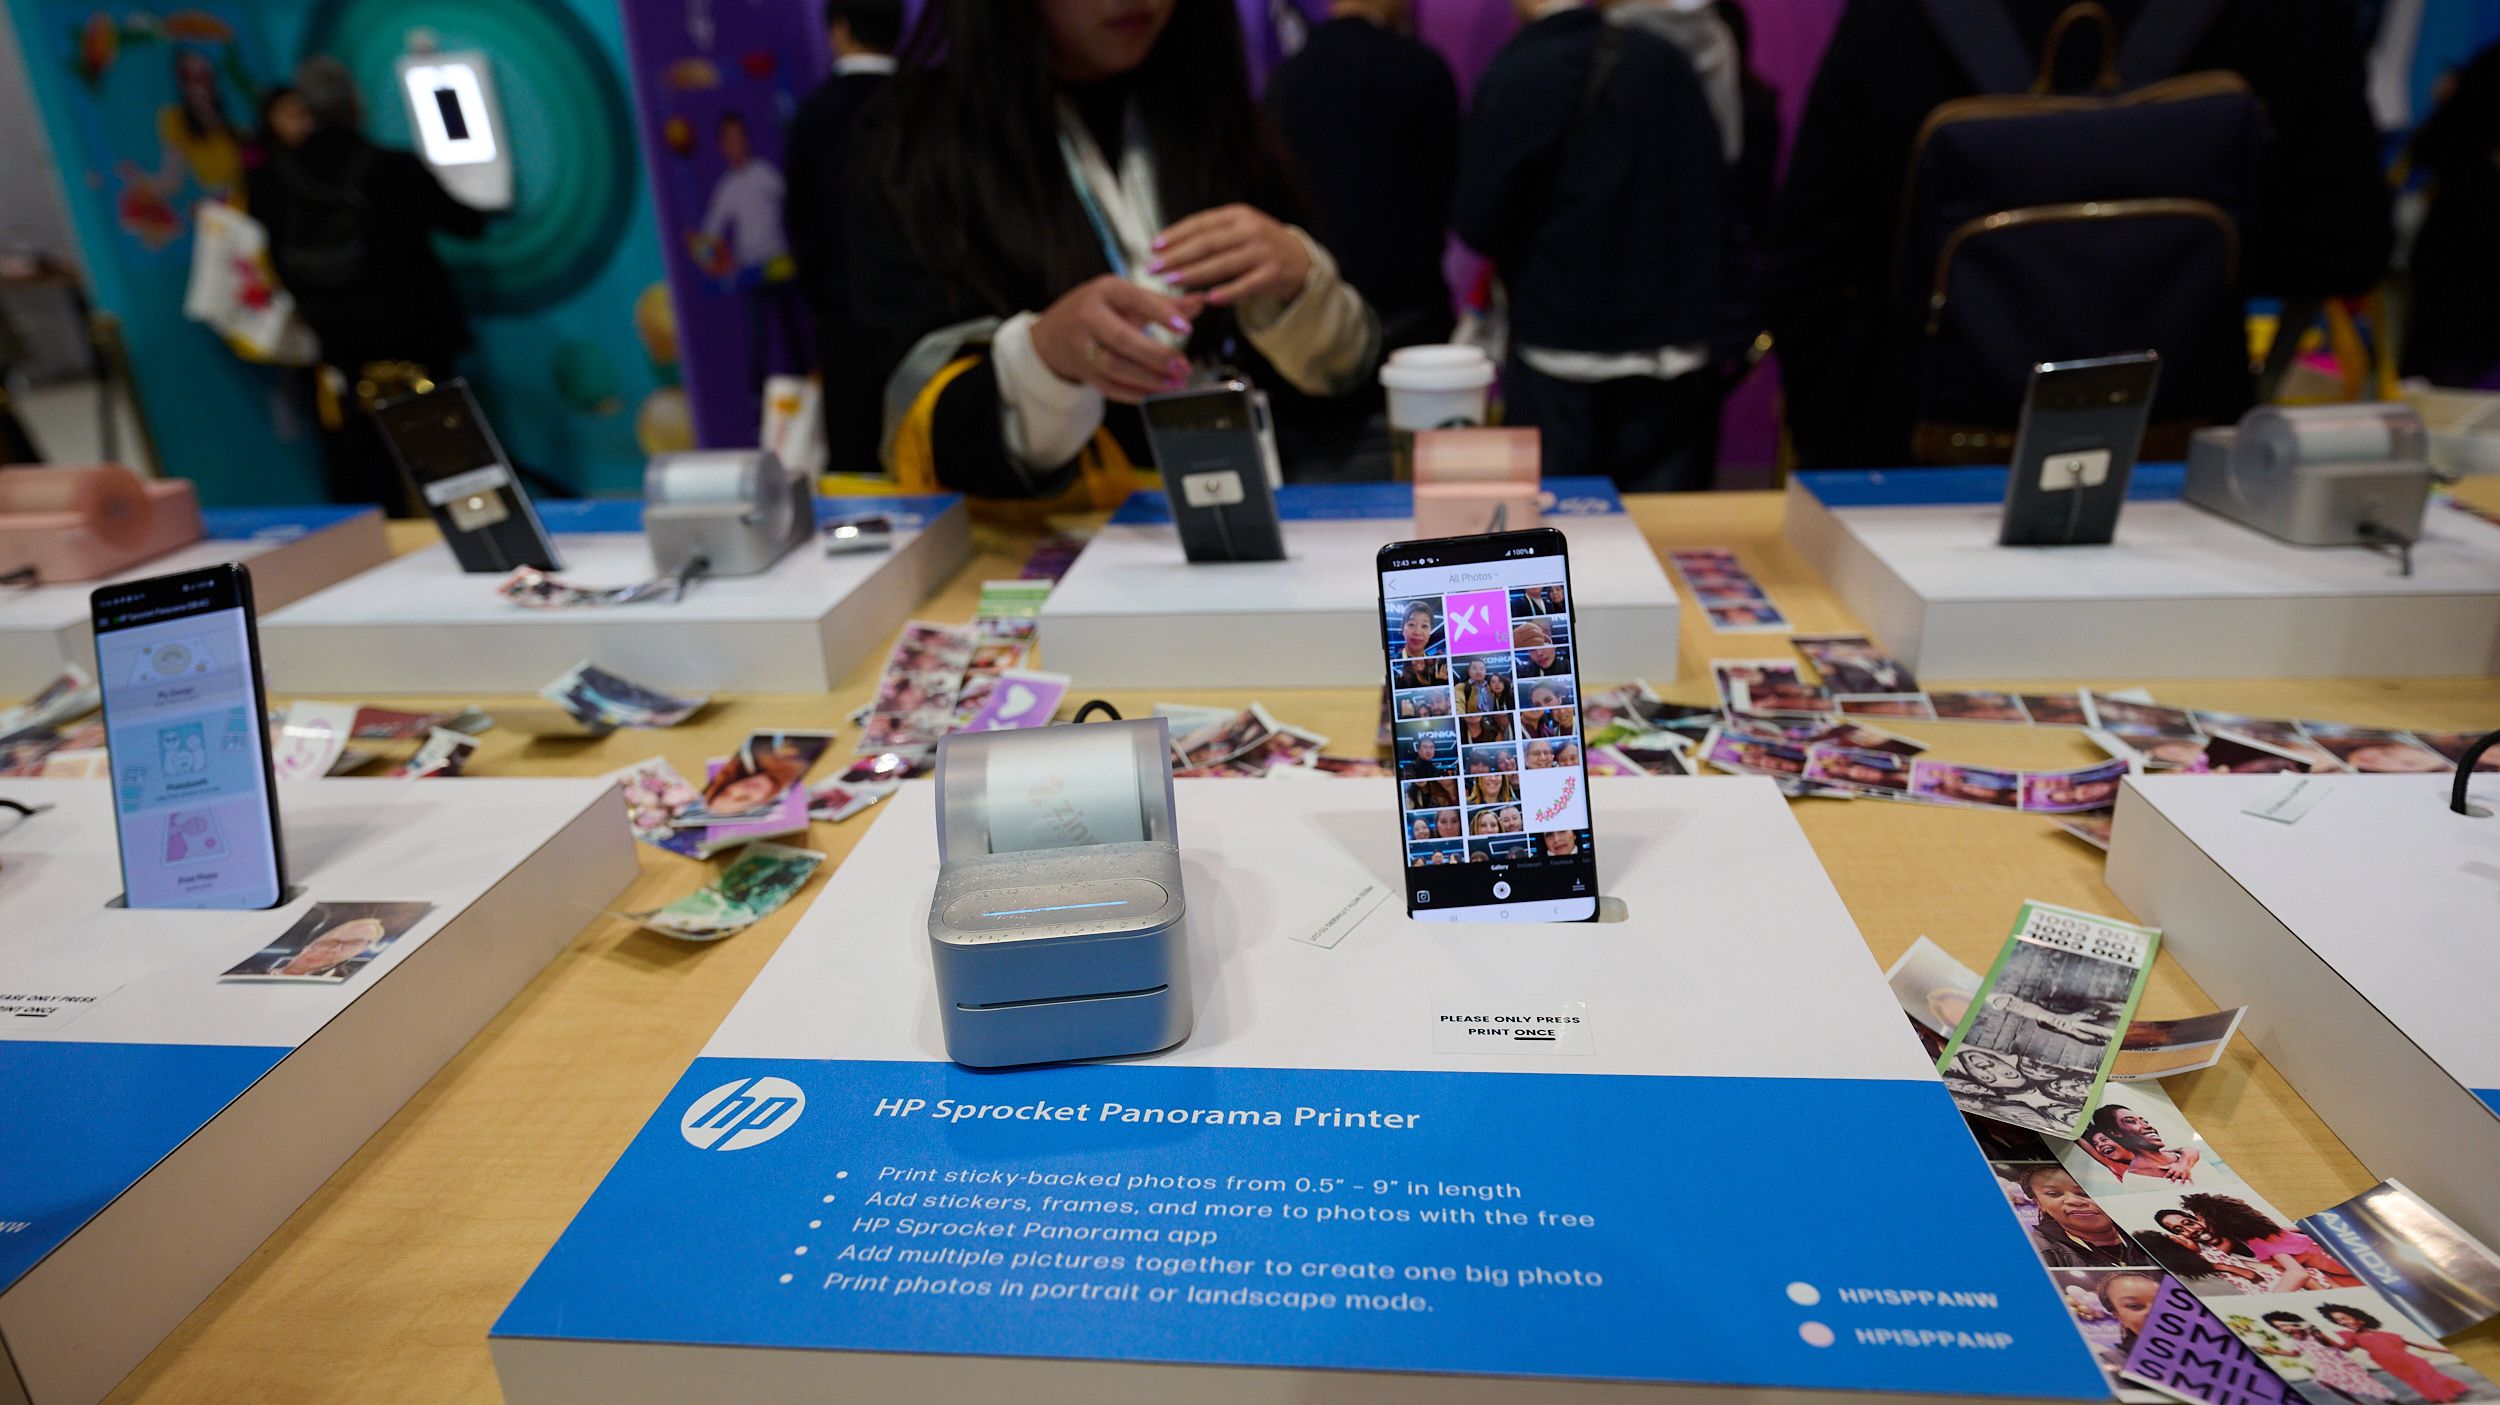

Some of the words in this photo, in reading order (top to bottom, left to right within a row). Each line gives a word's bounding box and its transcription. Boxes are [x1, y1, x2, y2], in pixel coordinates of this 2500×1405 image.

[1393, 560, 1410, 568] 12:43
[1449, 575, 1460, 584] All
[1462, 572, 1493, 581] Photos
[2091, 948, 2133, 964] TOO
[2094, 938, 2138, 955] TOO
[1440, 1015, 1490, 1023] PLEASE
[1494, 1016, 1532, 1024] ONLY
[1536, 1016, 1581, 1024] PRESS
[1468, 1028, 1510, 1036] PRINT
[1514, 1029, 1556, 1037] ONCE
[873, 1098, 926, 1118] HP
[931, 1099, 1091, 1124] Sprocket
[1099, 1102, 1283, 1127] Panorama
[1294, 1106, 1421, 1129] Printer
[877, 1166, 938, 1182] Print
[944, 1168, 1122, 1187] sticky-backed
[1127, 1173, 1217, 1191] photos
[1227, 1175, 1287, 1192] from
[1407, 1181, 1429, 1196] in
[1438, 1181, 1522, 1201] length
[864, 1191, 918, 1208] Add
[922, 1193, 1031, 1213] stickers,
[1042, 1196, 1140, 1216] frames,
[1148, 1201, 1198, 1216] and
[1204, 1204, 1273, 1218] more
[1283, 1204, 1309, 1220] to
[1317, 1204, 1411, 1223] photos
[1419, 1208, 1476, 1224] with
[1485, 1209, 1529, 1225] the
[1538, 1210, 1597, 1228] free
[852, 1217, 891, 1233] HP
[896, 1218, 1017, 1237] Sprocket
[1023, 1222, 1160, 1242] Panorama
[1167, 1229, 1218, 1247] app
[2316, 1211, 2401, 1285] KONKA
[836, 1244, 894, 1262] Add
[897, 1247, 1005, 1268] multiple
[1011, 1250, 1126, 1270] pictures
[1135, 1254, 1256, 1277] together
[1265, 1258, 1293, 1277] to
[1301, 1261, 1396, 1281] create
[1404, 1265, 1458, 1283] one
[1465, 1264, 1510, 1288] big
[1518, 1265, 1605, 1289] photo
[822, 1272, 889, 1293] Print
[893, 1274, 993, 1297] photos
[1000, 1279, 1025, 1297] in
[1030, 1281, 1141, 1302] portrait
[1149, 1285, 1179, 1303] or
[1187, 1284, 1338, 1312] landscape
[1345, 1292, 1435, 1313] mode.
[1837, 1287, 1999, 1310] HPISPPANW
